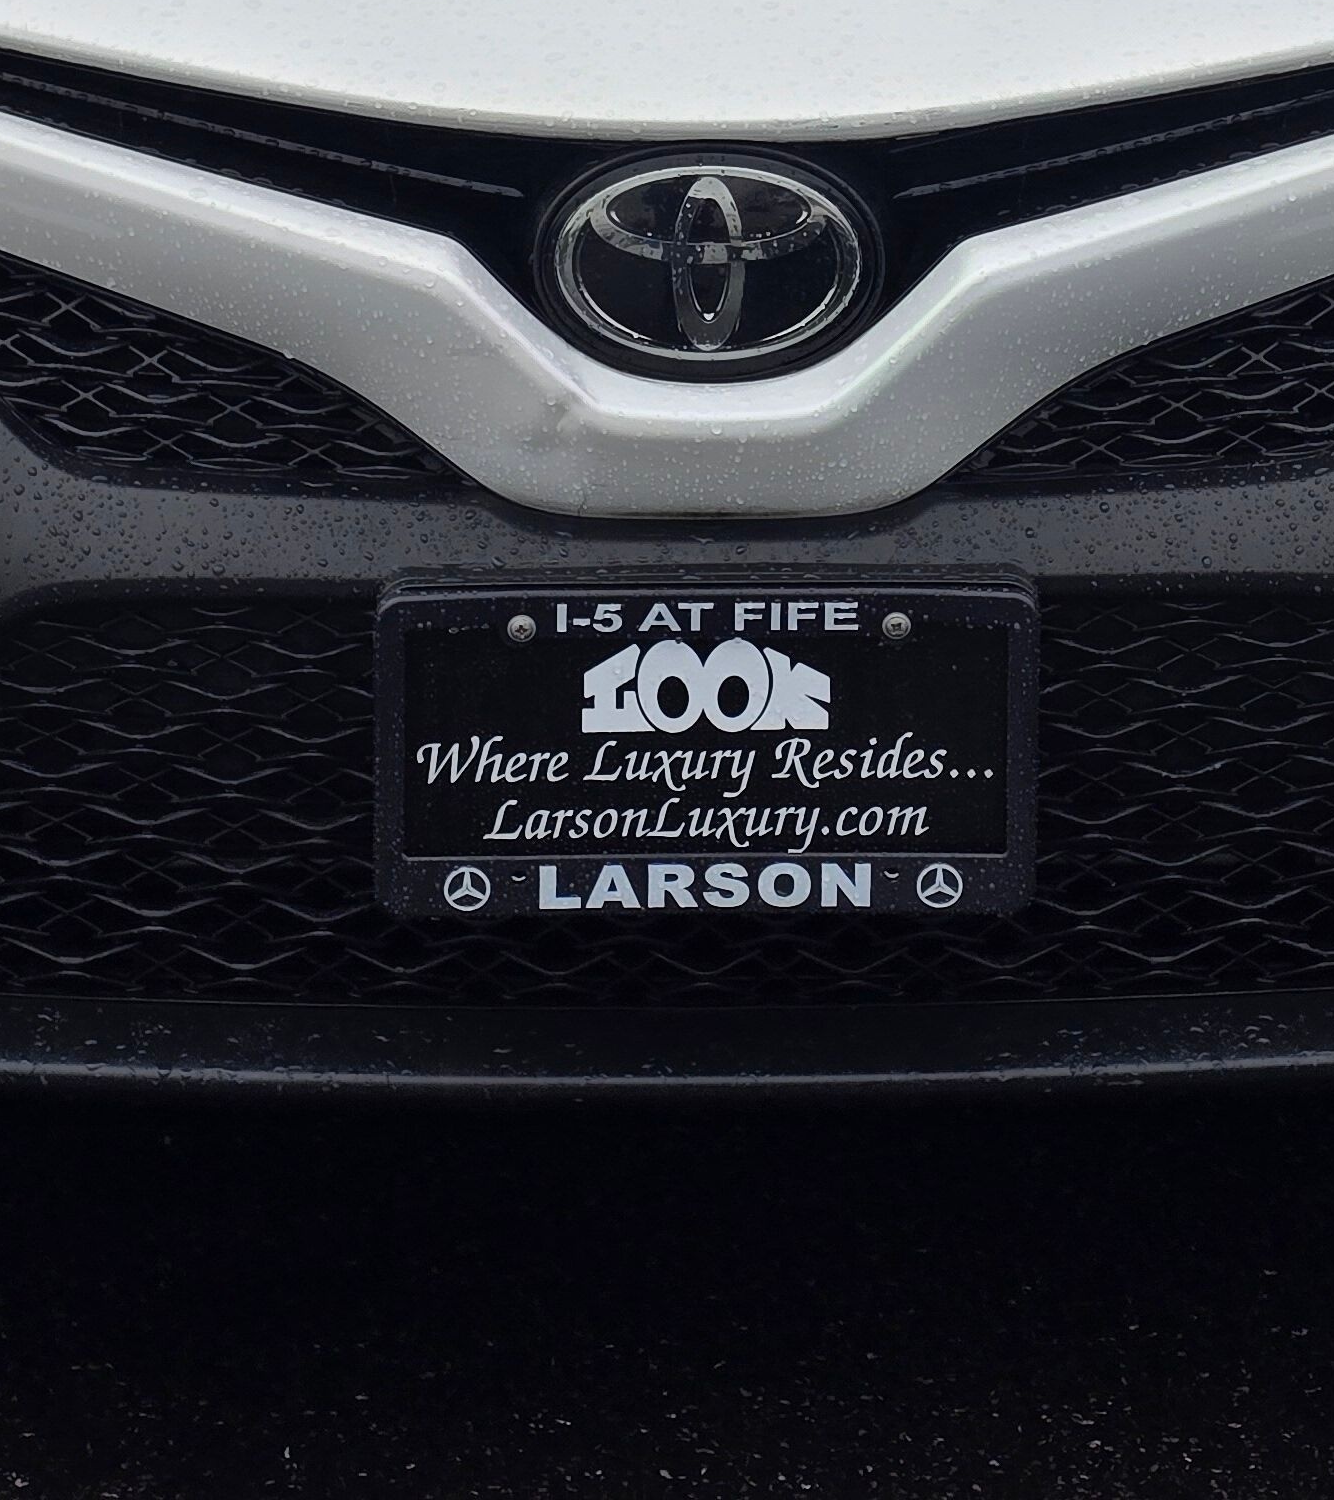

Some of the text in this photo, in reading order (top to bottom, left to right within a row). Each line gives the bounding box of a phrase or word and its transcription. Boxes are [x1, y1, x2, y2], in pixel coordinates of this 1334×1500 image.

[556, 602, 859, 633] I-5 AT FIFE
[581, 638, 831, 733] LOOK
[417, 732, 994, 798] Where Luxury Resides...
[484, 798, 929, 854] LarsonLuxury.com
[538, 862, 872, 910] LARSON
